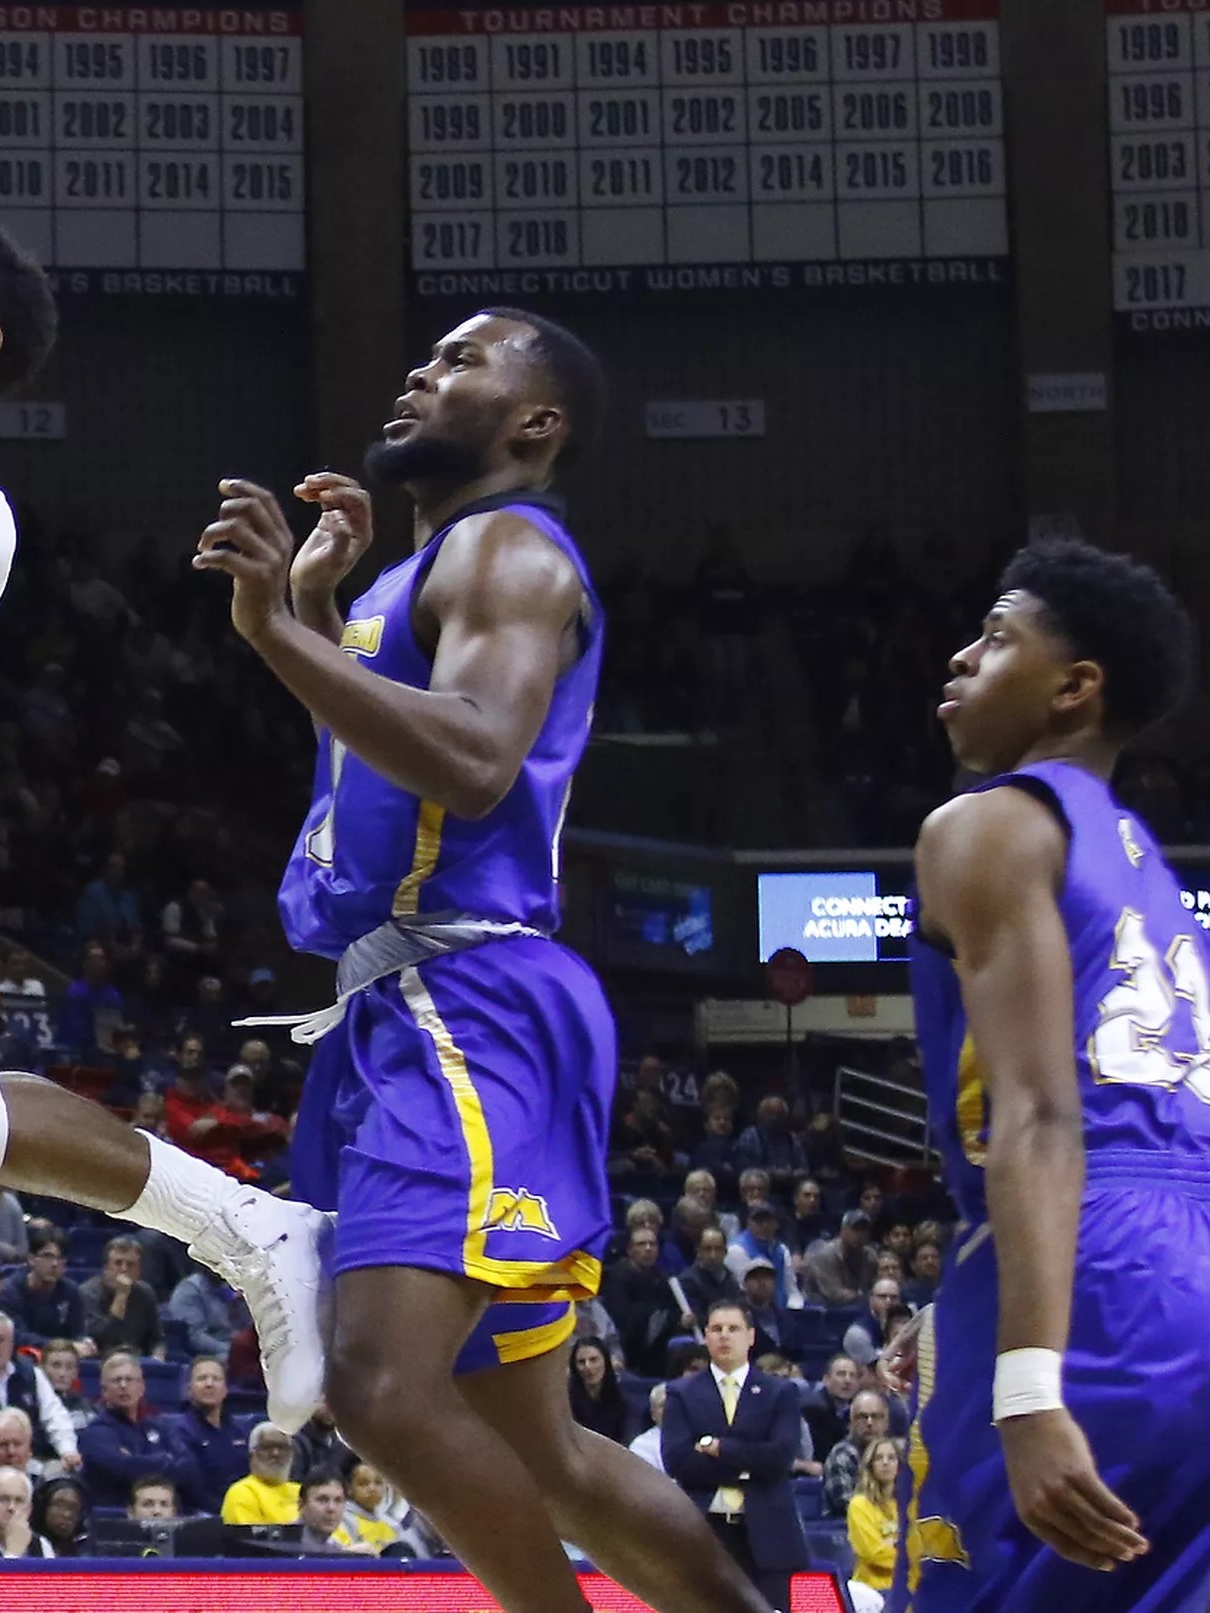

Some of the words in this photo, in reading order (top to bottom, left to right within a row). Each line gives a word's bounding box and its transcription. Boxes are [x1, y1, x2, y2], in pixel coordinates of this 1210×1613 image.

[78, 8, 289, 32] CHAMPIONS
[462, 6, 702, 31] TOURNAMENT
[728, 0, 943, 24] CHAMPIONS
[419, 45, 478, 82] 1989
[506, 44, 561, 80] 1991
[588, 41, 646, 77] 1994
[674, 38, 731, 75] 1995
[758, 36, 818, 73] 1996
[844, 34, 901, 70] 1997
[929, 31, 987, 68] 1998
[1118, 23, 1179, 61] 1989
[65, 43, 123, 78] 1995
[150, 44, 207, 80] 1996
[234, 45, 289, 82] 1997
[63, 101, 126, 138] 2002
[147, 103, 209, 139] 2003
[231, 104, 293, 141] 2004
[421, 104, 480, 141] 1999
[503, 101, 567, 138] 2000
[590, 100, 649, 136] 2001
[672, 97, 735, 134] 2002
[757, 95, 822, 132] 2005
[843, 92, 908, 130] 2006
[928, 90, 993, 128] 2008
[1121, 82, 1182, 121] 1996
[66, 161, 125, 198] 2011
[148, 162, 209, 199] 2014
[232, 163, 292, 200] 2015
[420, 163, 483, 200] 2009
[506, 161, 567, 198] 2010
[592, 159, 651, 196] 2011
[678, 156, 737, 193] 2012
[761, 153, 823, 190] 2014
[846, 151, 906, 188] 2015
[931, 148, 992, 186] 2016
[1121, 142, 1186, 181] 2003
[424, 222, 481, 259] 2017
[509, 219, 568, 256] 2018
[1125, 202, 1188, 240] 2010
[104, 272, 299, 297] BASKETBALL
[418, 272, 631, 295] CONNECTICUT
[647, 266, 791, 290] WOMEN'S
[804, 261, 1005, 286] BASKETBALL
[1126, 264, 1186, 303] 2017
[20, 408, 51, 433] 12
[719, 405, 752, 432] 13
[803, 918, 873, 938] ACURA
